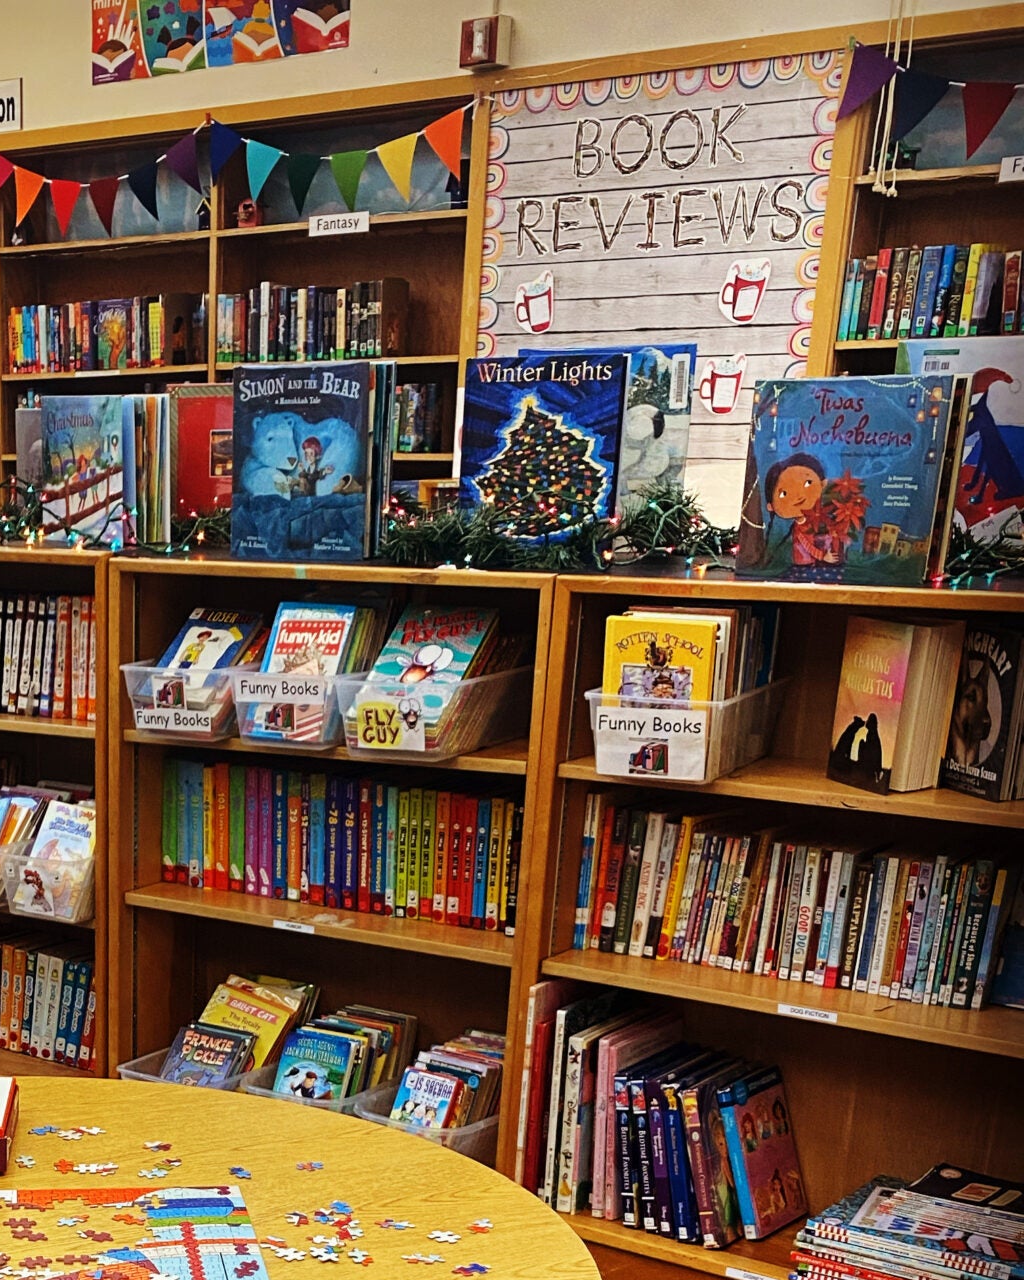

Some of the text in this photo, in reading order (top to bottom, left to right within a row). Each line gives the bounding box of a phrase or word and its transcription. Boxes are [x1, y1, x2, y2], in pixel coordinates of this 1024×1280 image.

[573, 103, 748, 179] BOOK
[317, 217, 360, 231] Fantasy
[516, 179, 807, 258] REVIEWS
[477, 360, 612, 386] Winter Lights
[239, 372, 360, 401] SIMON AND THE BEAR
[46, 411, 94, 435] Christmas
[789, 414, 912, 448] Nochebuena
[207, 611, 239, 624] LOSER
[279, 628, 342, 647] funny kid
[616, 631, 705, 660] ROTTEN SCHOOL
[853, 651, 890, 675] CHASING
[967, 632, 1012, 676] NGHEART
[240, 680, 319, 698] Funny Books
[846, 675, 895, 699] AUGUSTUS
[136, 710, 210, 728] Funny Books
[365, 708, 396, 726] FLY
[598, 714, 702, 735] Funny Books
[362, 726, 399, 744] GUY
[328, 809, 338, 825] 78
[345, 811, 354, 827] 78
[794, 905, 810, 955] GOOD DOG
[257, 1009, 276, 1024] CAT
[804, 1009, 829, 1019] FICTION
[184, 1030, 234, 1053] FRANKIE
[182, 1044, 226, 1066] PICKLE
